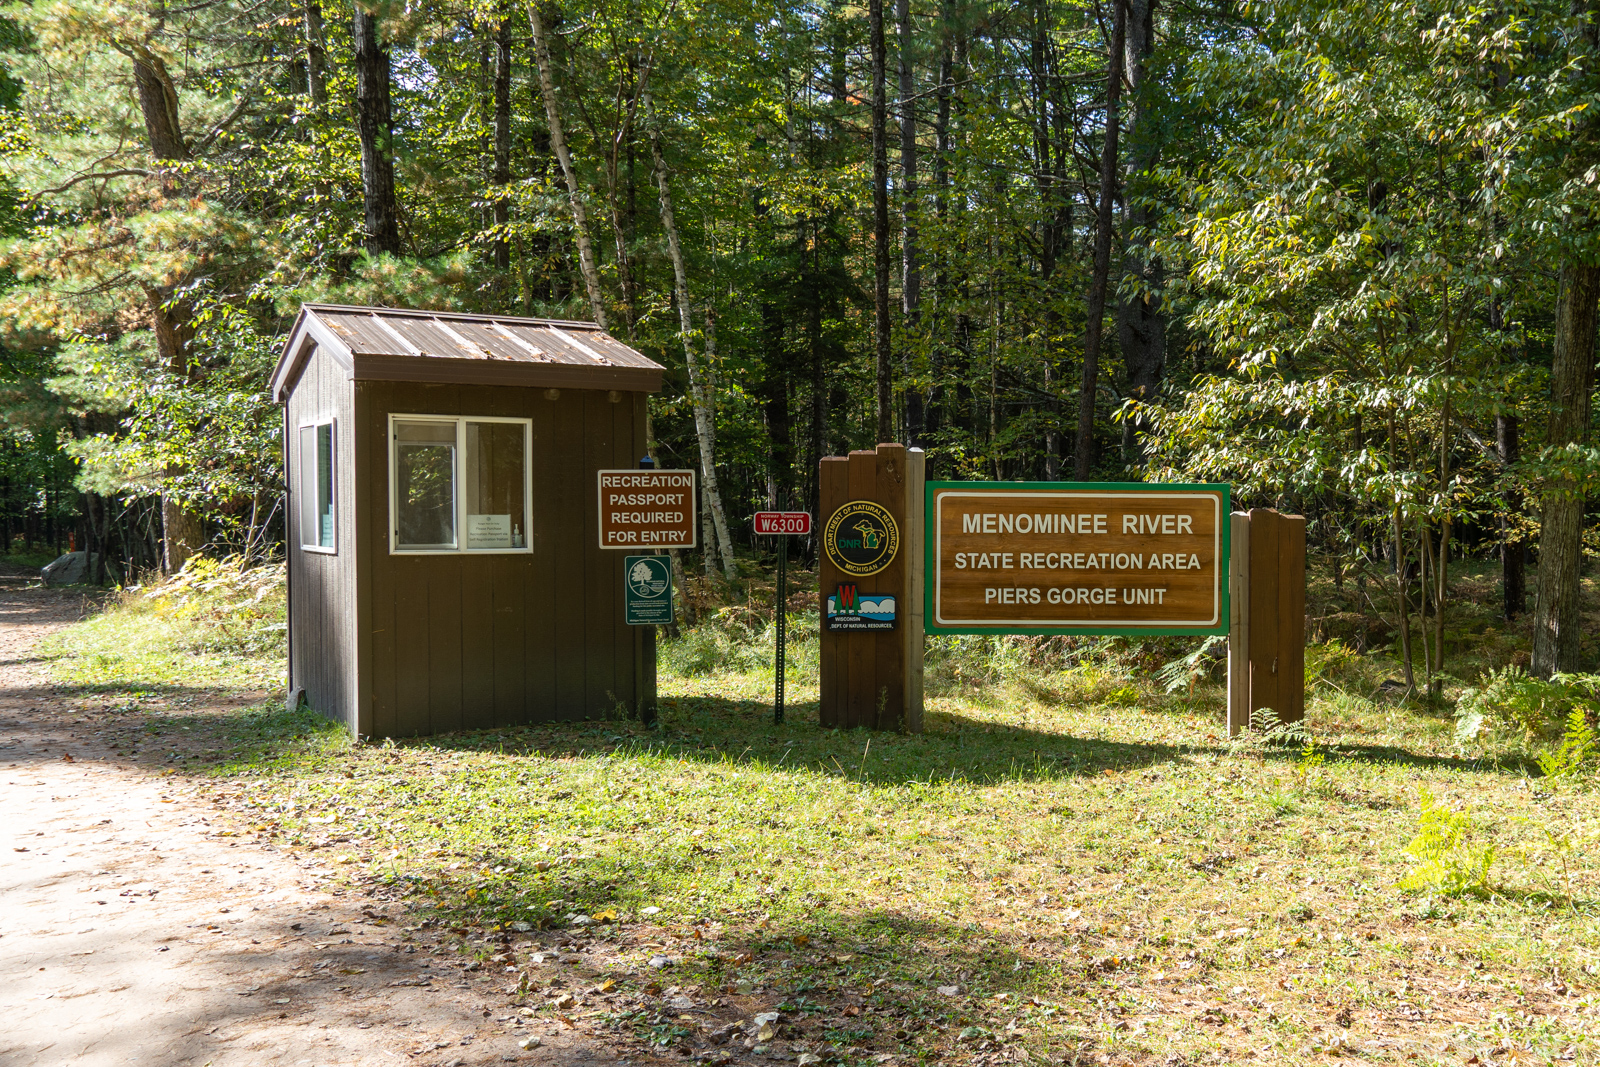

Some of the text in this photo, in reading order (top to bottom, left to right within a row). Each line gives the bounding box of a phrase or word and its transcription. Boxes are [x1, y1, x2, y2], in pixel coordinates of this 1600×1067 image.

[602, 476, 691, 488] RECREATION
[610, 494, 684, 506] PASSPORT
[612, 512, 684, 524] REQUIRED
[962, 514, 1193, 534] MENOMINEE RIVER
[762, 519, 804, 531] W6300
[828, 504, 896, 556] DEPARTMENT OF NATURAL RESOURCES
[608, 530, 687, 542] FOR ENTRY
[838, 540, 861, 548] DNR
[955, 552, 1201, 569] STATE RECREATION AREA
[845, 563, 878, 572] MICHIGAN
[839, 585, 856, 606] W
[985, 588, 1166, 604] PIERS GORGE UNIT
